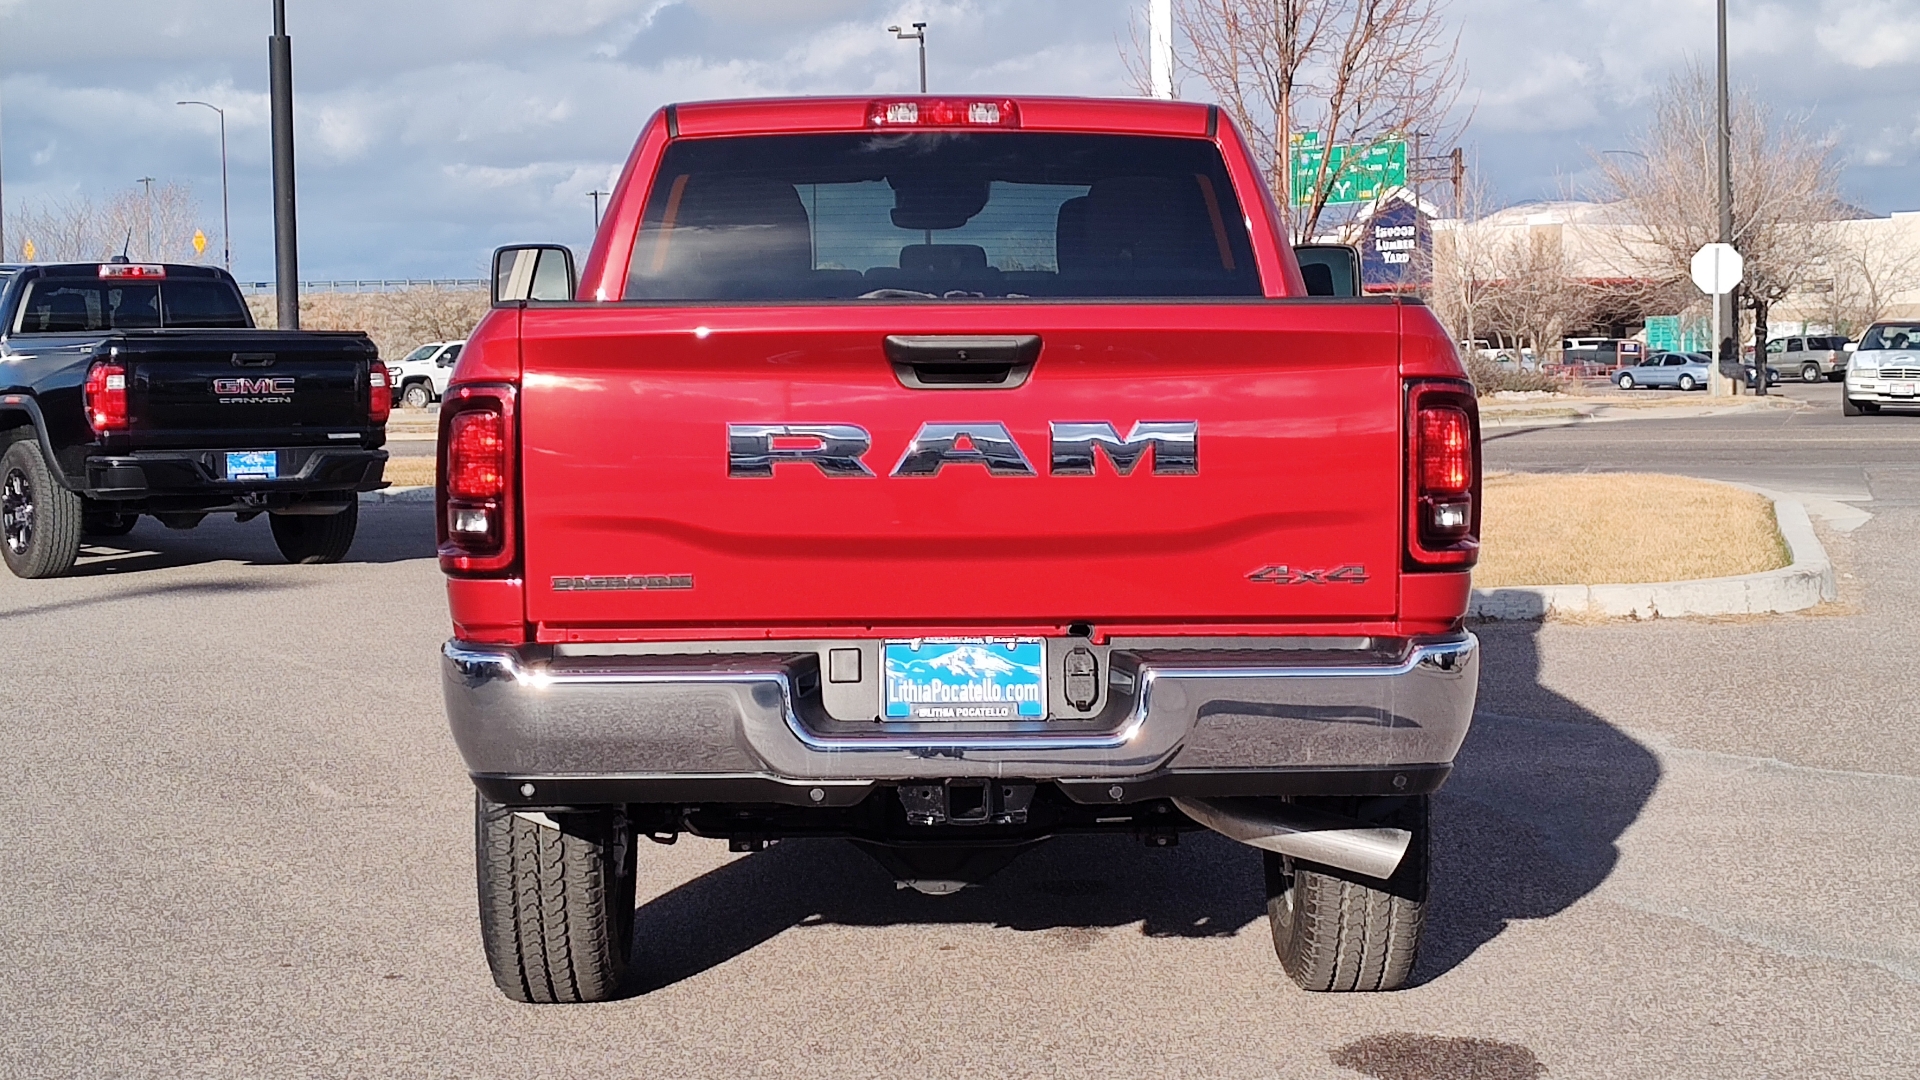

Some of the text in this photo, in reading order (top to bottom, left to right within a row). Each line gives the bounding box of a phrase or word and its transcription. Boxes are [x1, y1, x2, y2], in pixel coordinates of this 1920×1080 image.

[1375, 239, 1416, 251] LUMBER
[1382, 251, 1410, 263] YARD
[213, 378, 295, 394] GMC
[726, 420, 1199, 477] RAM
[1244, 563, 1370, 584] 4x4
[889, 678, 1039, 703] LithiaPocatello.com
[929, 707, 1009, 717] LITHIA POCATELLO
